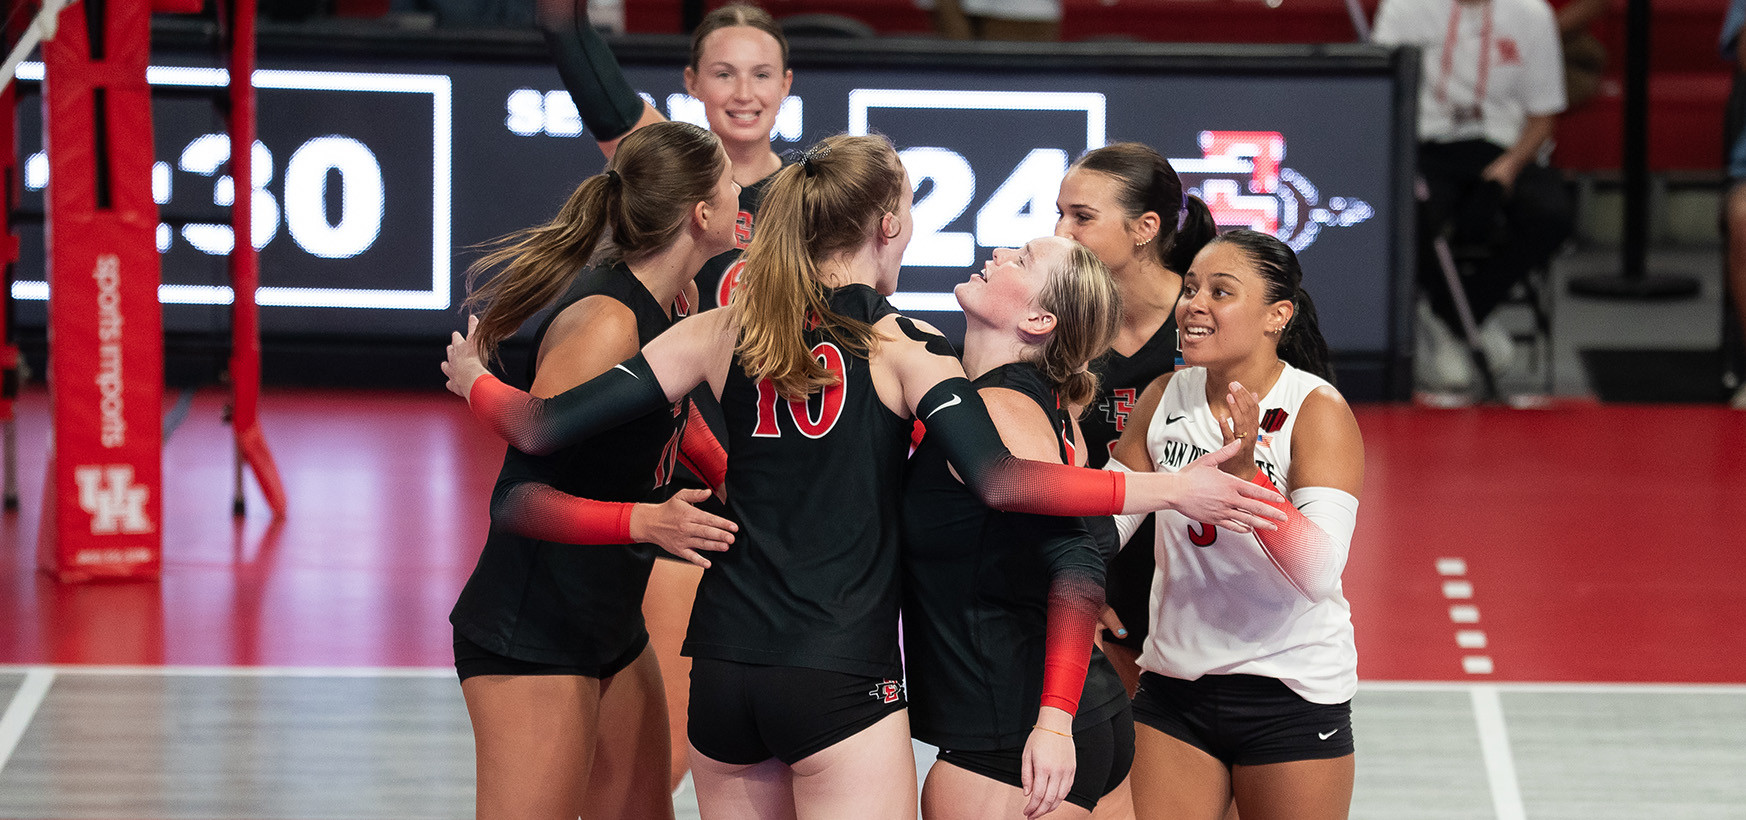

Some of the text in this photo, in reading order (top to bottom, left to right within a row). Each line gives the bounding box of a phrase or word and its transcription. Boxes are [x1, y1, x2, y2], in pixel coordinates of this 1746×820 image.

[896, 146, 1070, 267] 24
[93, 254, 124, 341] sports
[751, 341, 847, 439] 10
[1160, 440, 1188, 467] SAN
